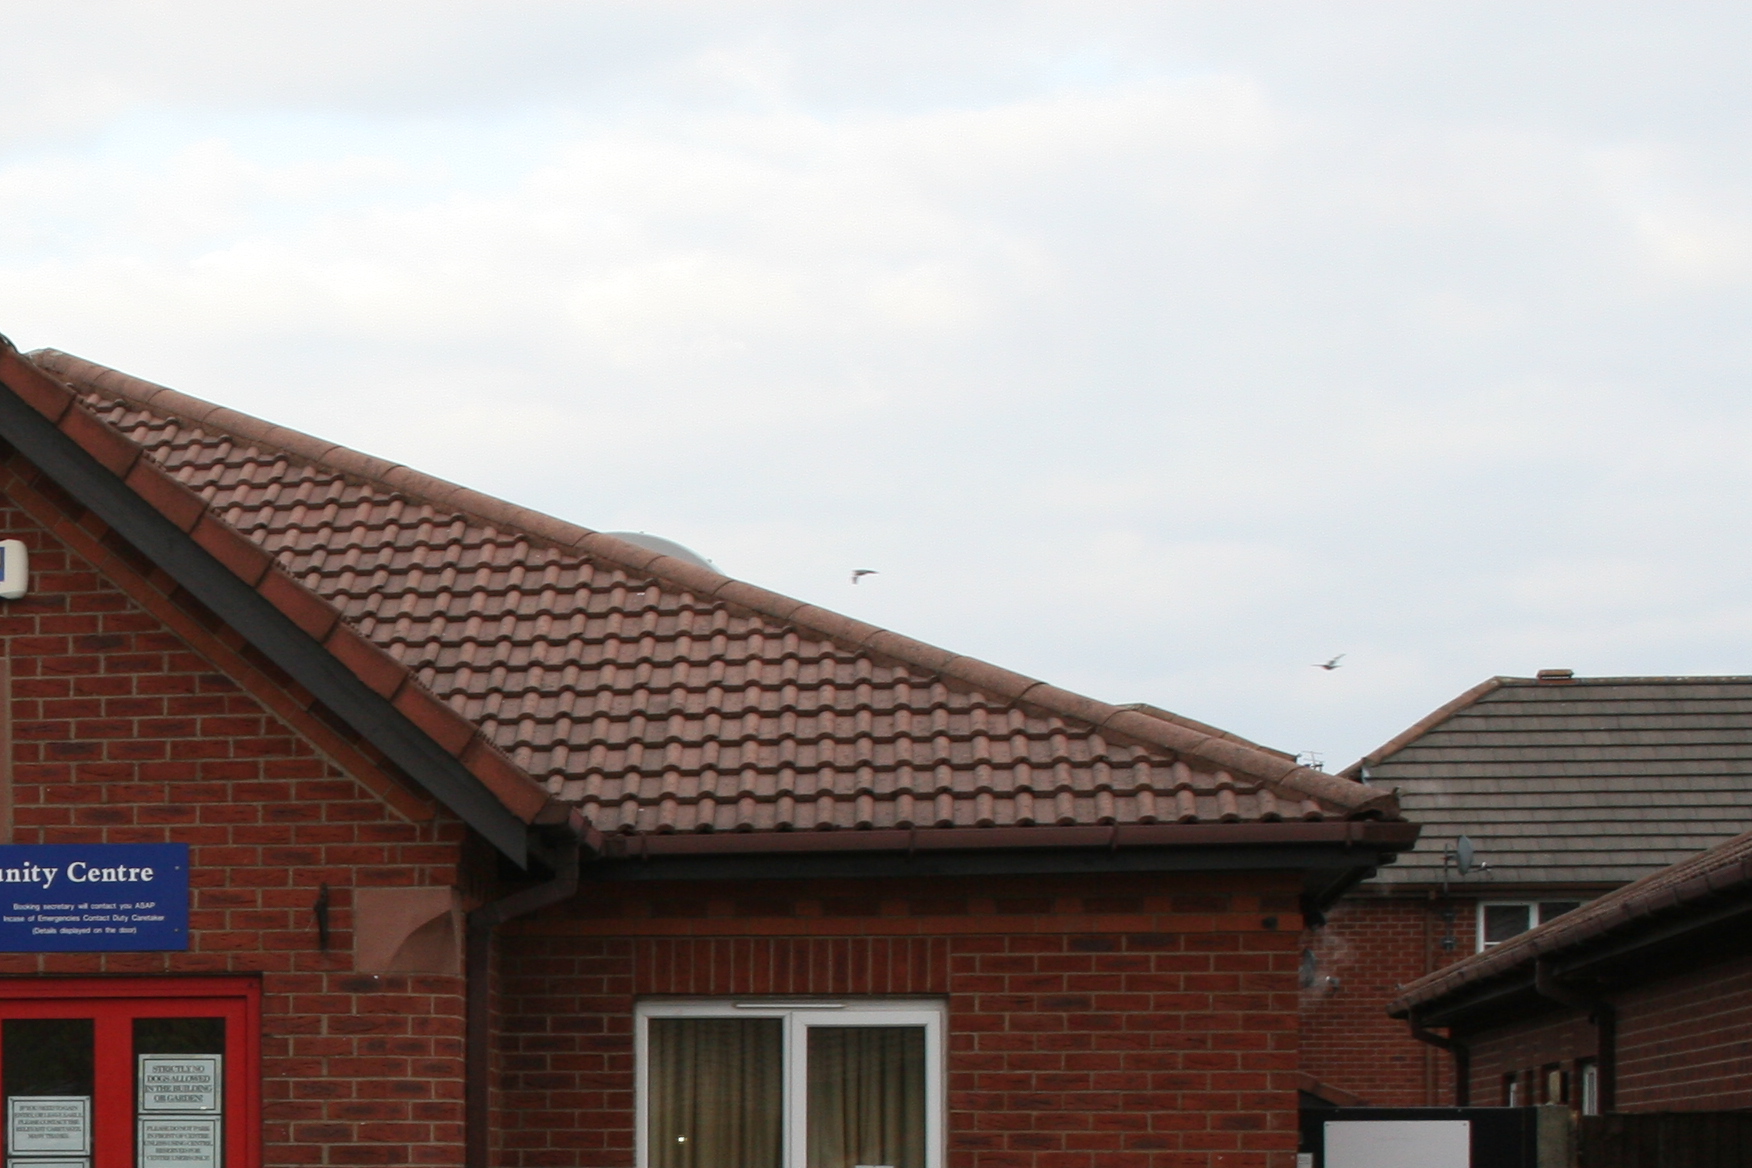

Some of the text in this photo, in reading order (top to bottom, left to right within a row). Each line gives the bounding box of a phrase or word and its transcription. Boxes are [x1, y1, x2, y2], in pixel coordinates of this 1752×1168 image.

[67, 861, 154, 882] Centre
[156, 1085, 172, 1093] THE
[173, 1085, 212, 1093] BUILDING
[154, 1094, 166, 1102] OR
